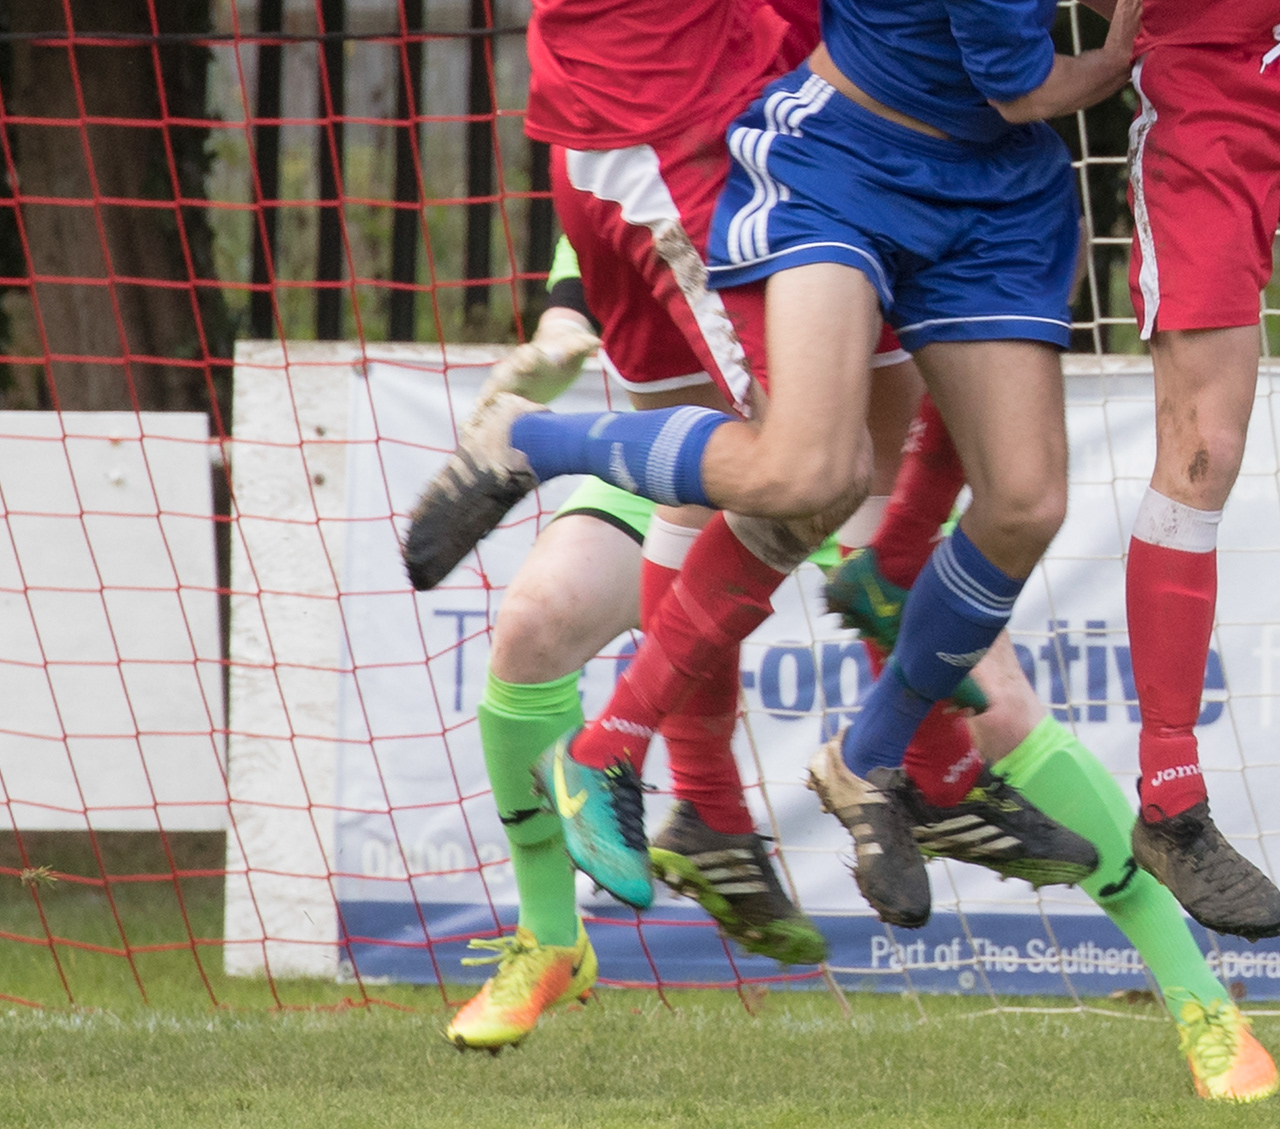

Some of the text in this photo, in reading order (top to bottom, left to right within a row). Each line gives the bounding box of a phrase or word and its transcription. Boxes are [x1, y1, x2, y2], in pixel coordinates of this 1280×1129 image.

[871, 935, 926, 970] Part
[934, 937, 961, 971] of
[971, 937, 1019, 972] The
